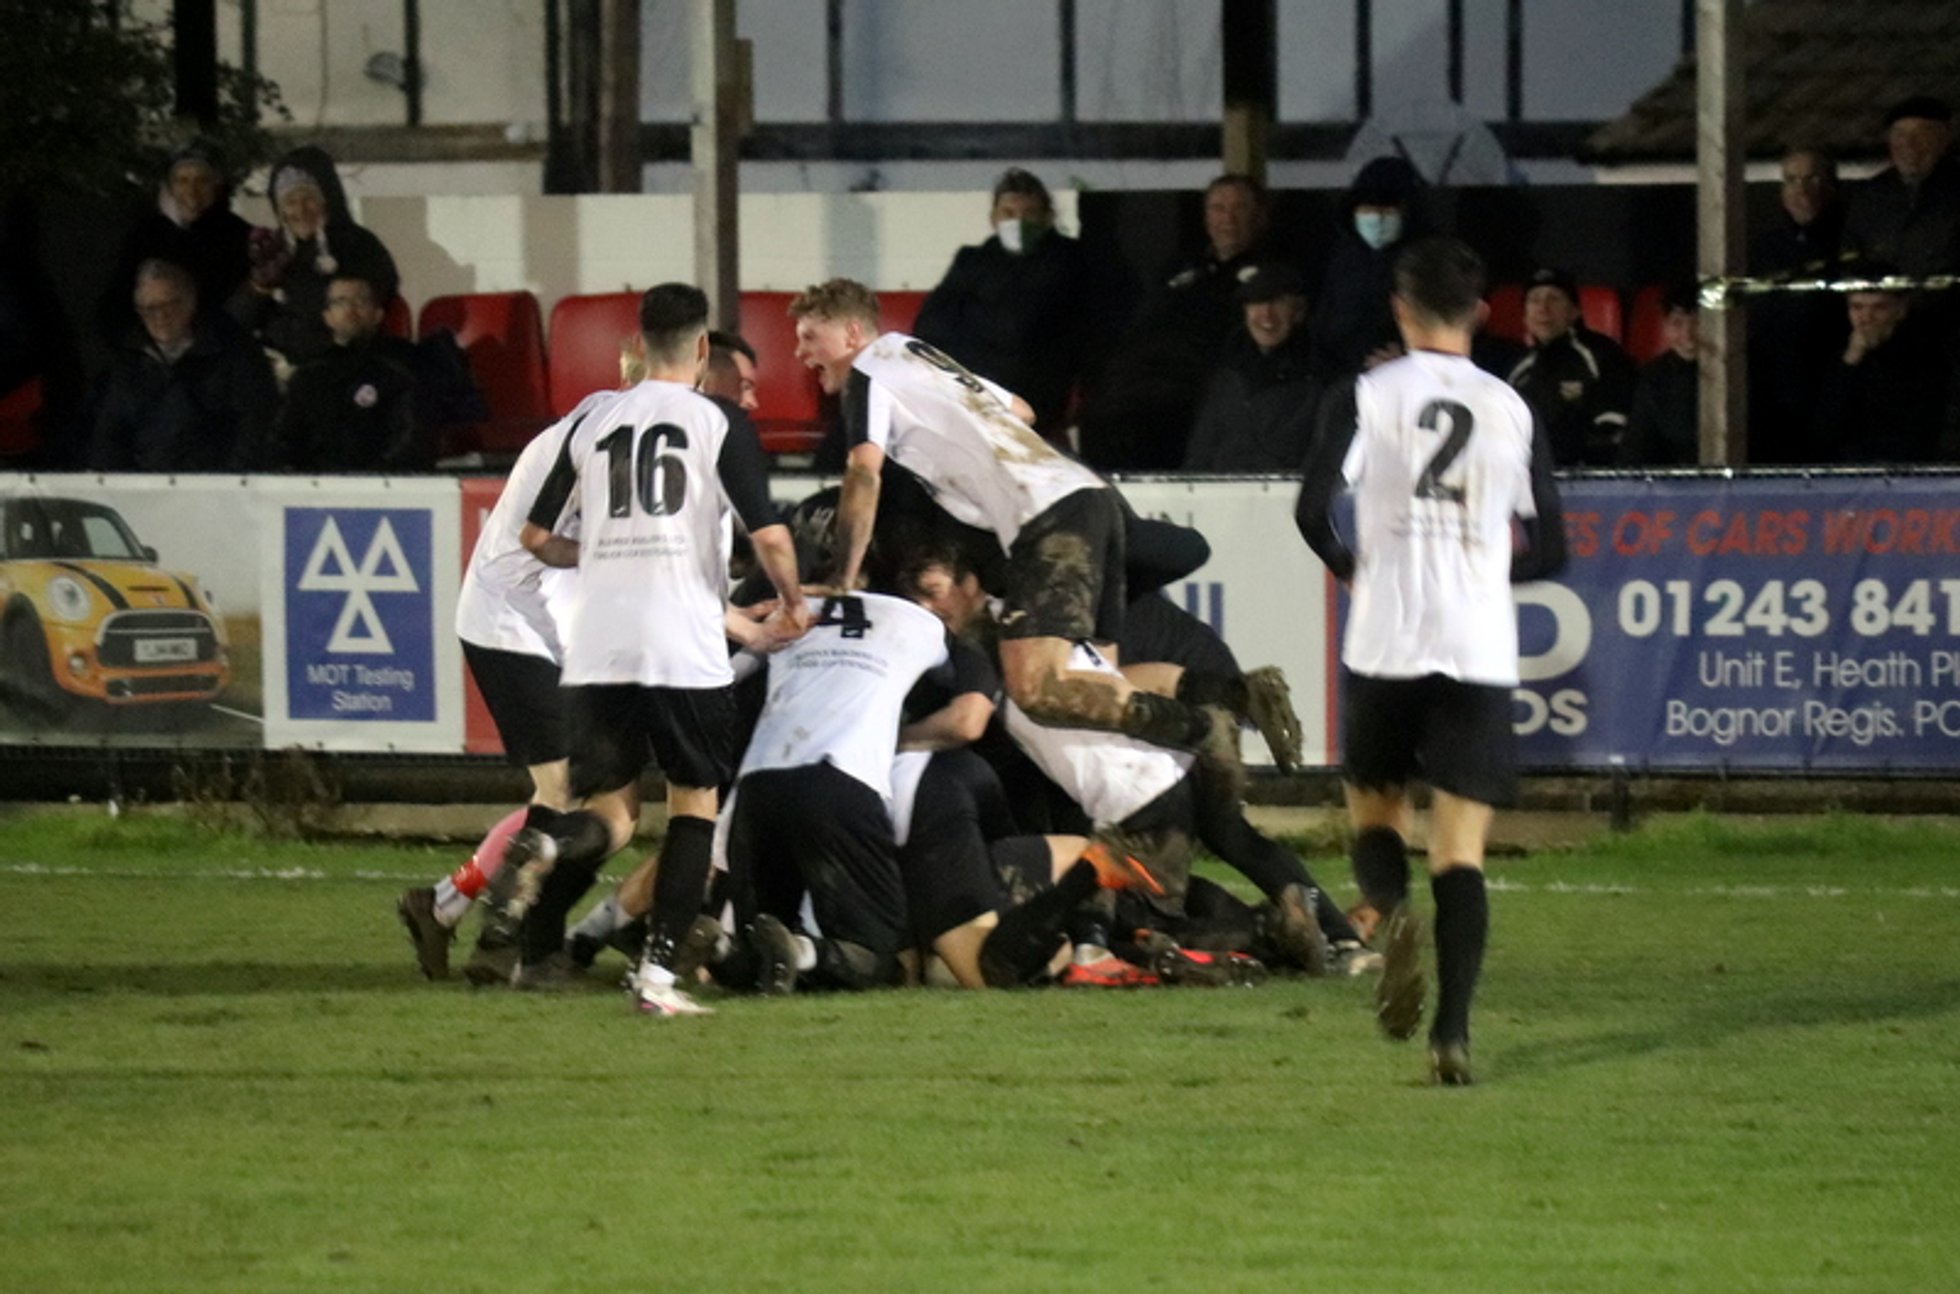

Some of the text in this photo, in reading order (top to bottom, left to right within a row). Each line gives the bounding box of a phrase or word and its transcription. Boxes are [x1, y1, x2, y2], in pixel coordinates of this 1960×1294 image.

[595, 423, 688, 519] 16
[1415, 399, 1473, 506] 2
[1612, 510, 1677, 556] OF
[1686, 508, 1809, 556] CARS
[1823, 508, 1960, 556] WORK
[816, 595, 872, 638] 4
[1618, 578, 1960, 637] 01243 841
[306, 664, 415, 692] MOT Testing
[1700, 651, 1767, 687] Unit
[1813, 651, 1922, 687] Heath
[331, 690, 392, 711] Station
[1666, 699, 1796, 745] Bognor
